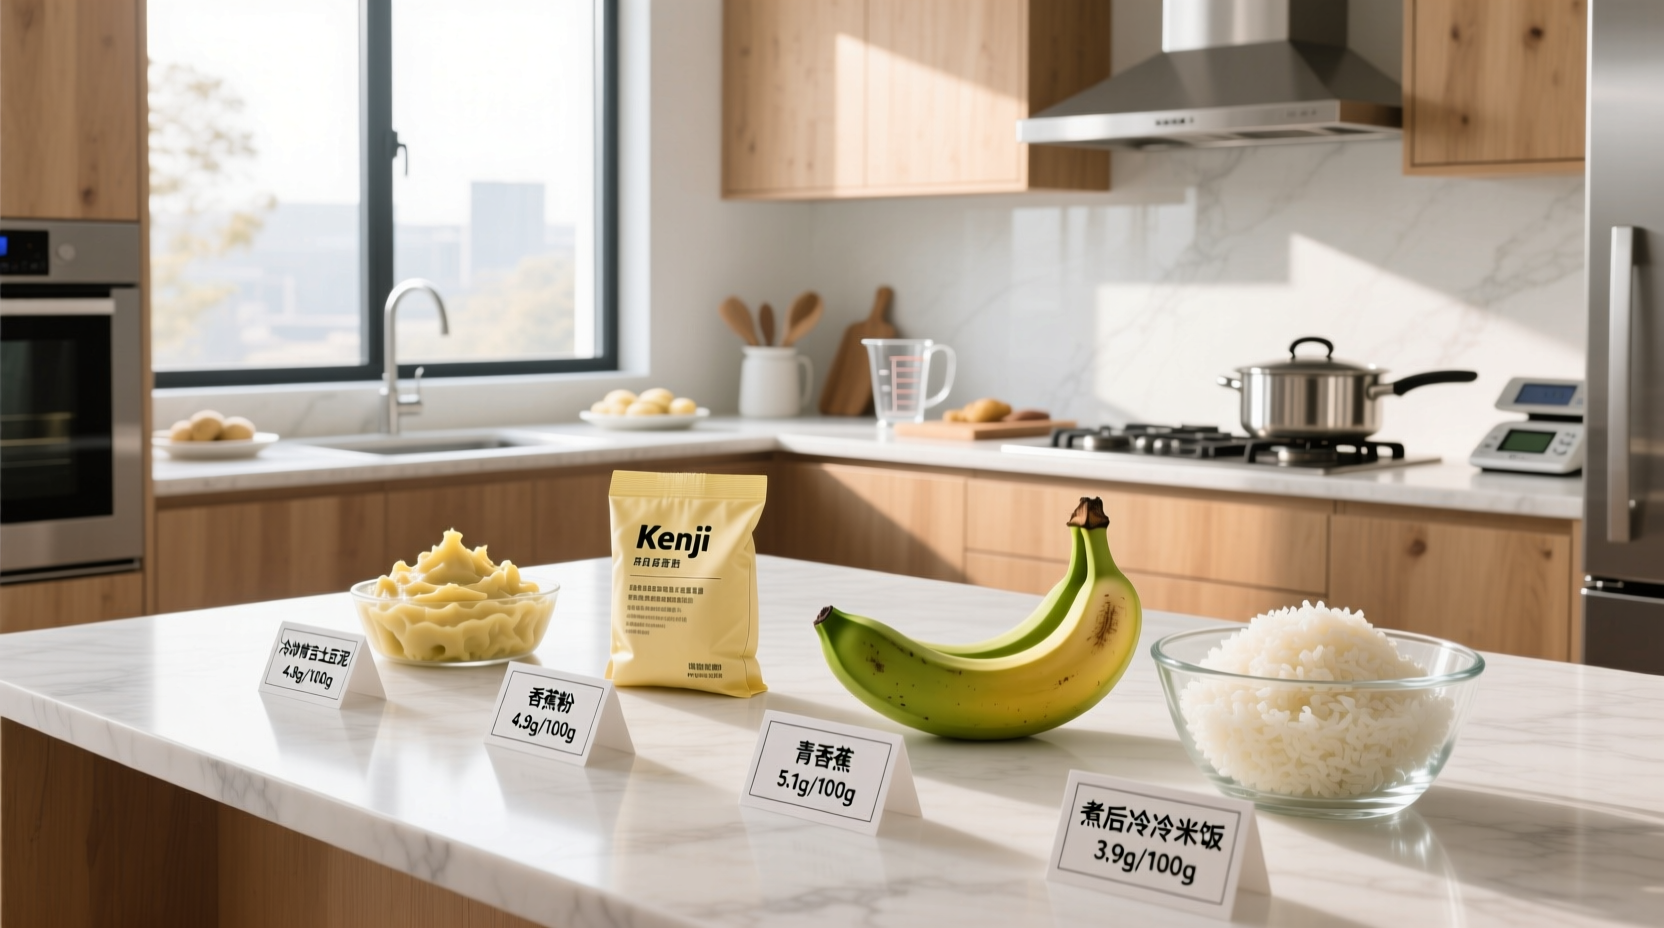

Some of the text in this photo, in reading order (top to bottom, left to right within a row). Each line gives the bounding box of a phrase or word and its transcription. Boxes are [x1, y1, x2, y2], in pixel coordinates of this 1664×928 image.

[636, 524, 712, 559] Kenji
[528, 687, 575, 714] 香蕉粉
[511, 712, 576, 744] 4.9g/100g
[777, 769, 856, 807] 5.1g/100g
[1080, 799, 1225, 851] 煮后冷冷米饭
[1094, 840, 1196, 886] 3.9g/100g
